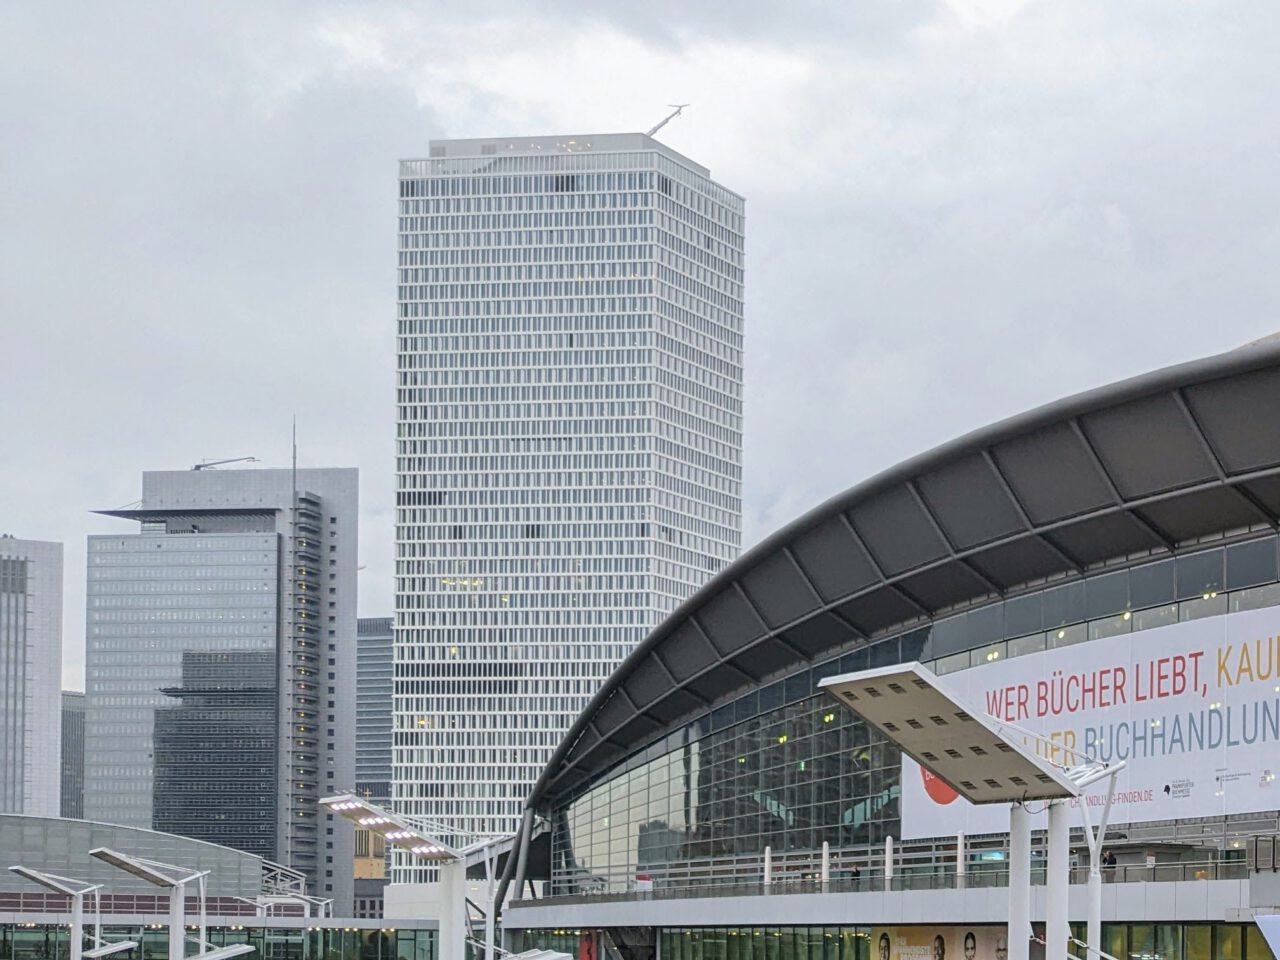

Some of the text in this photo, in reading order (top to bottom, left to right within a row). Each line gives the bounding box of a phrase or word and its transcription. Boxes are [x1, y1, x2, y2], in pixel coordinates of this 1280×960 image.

[986, 685, 1029, 723] WER
[1037, 667, 1127, 718] BÜCHER
[1135, 650, 1208, 702] LIEBT,
